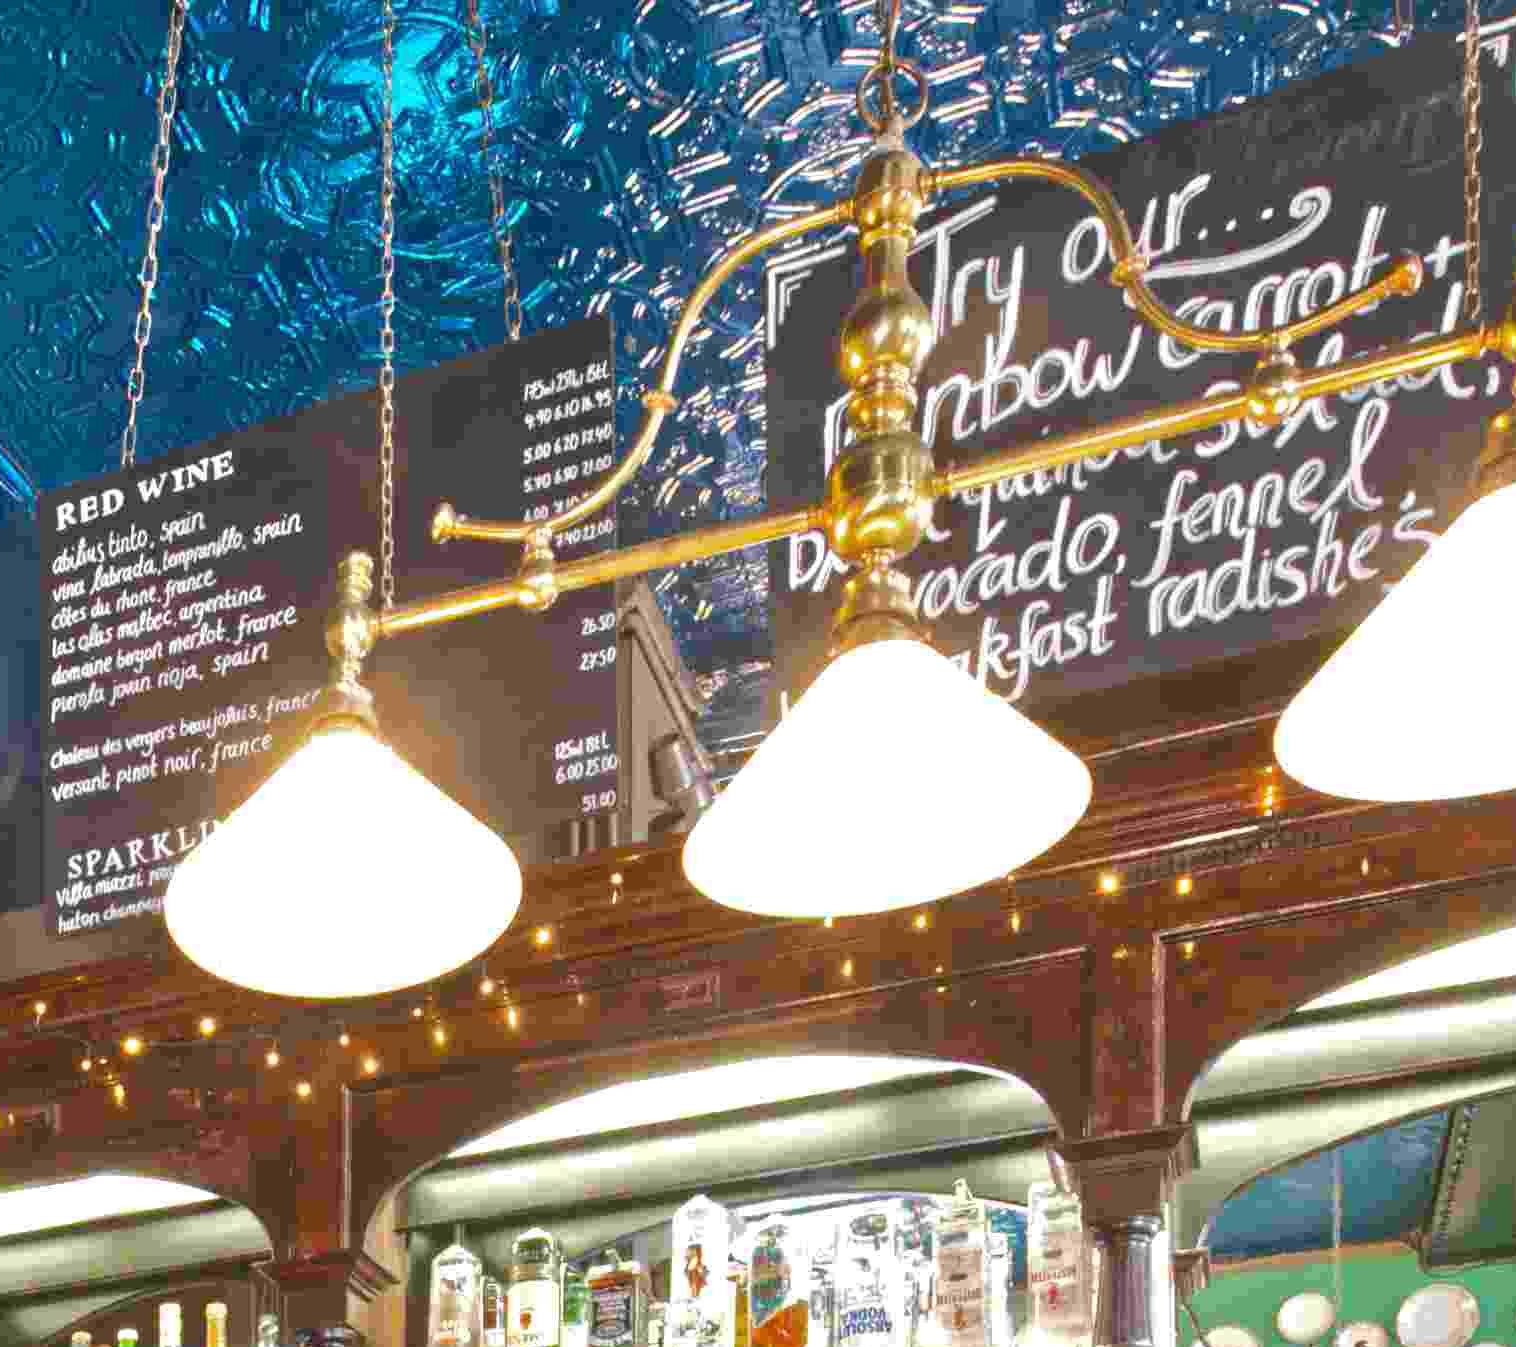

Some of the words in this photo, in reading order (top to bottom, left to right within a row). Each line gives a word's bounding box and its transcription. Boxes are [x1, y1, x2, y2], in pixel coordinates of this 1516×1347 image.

[908, 196, 1024, 372] Try
[56, 489, 125, 532] RED
[137, 450, 235, 502] WINE
[1131, 399, 1391, 588] fennel
[160, 510, 207, 544] spain
[253, 512, 304, 545] spain
[163, 568, 217, 609] france
[1148, 508, 1437, 637] radishes
[52, 637, 76, 659] las
[178, 584, 266, 629] argentina
[233, 605, 297, 645] france
[211, 639, 270, 678] spain
[115, 752, 160, 794] pinot
[207, 732, 273, 774] france
